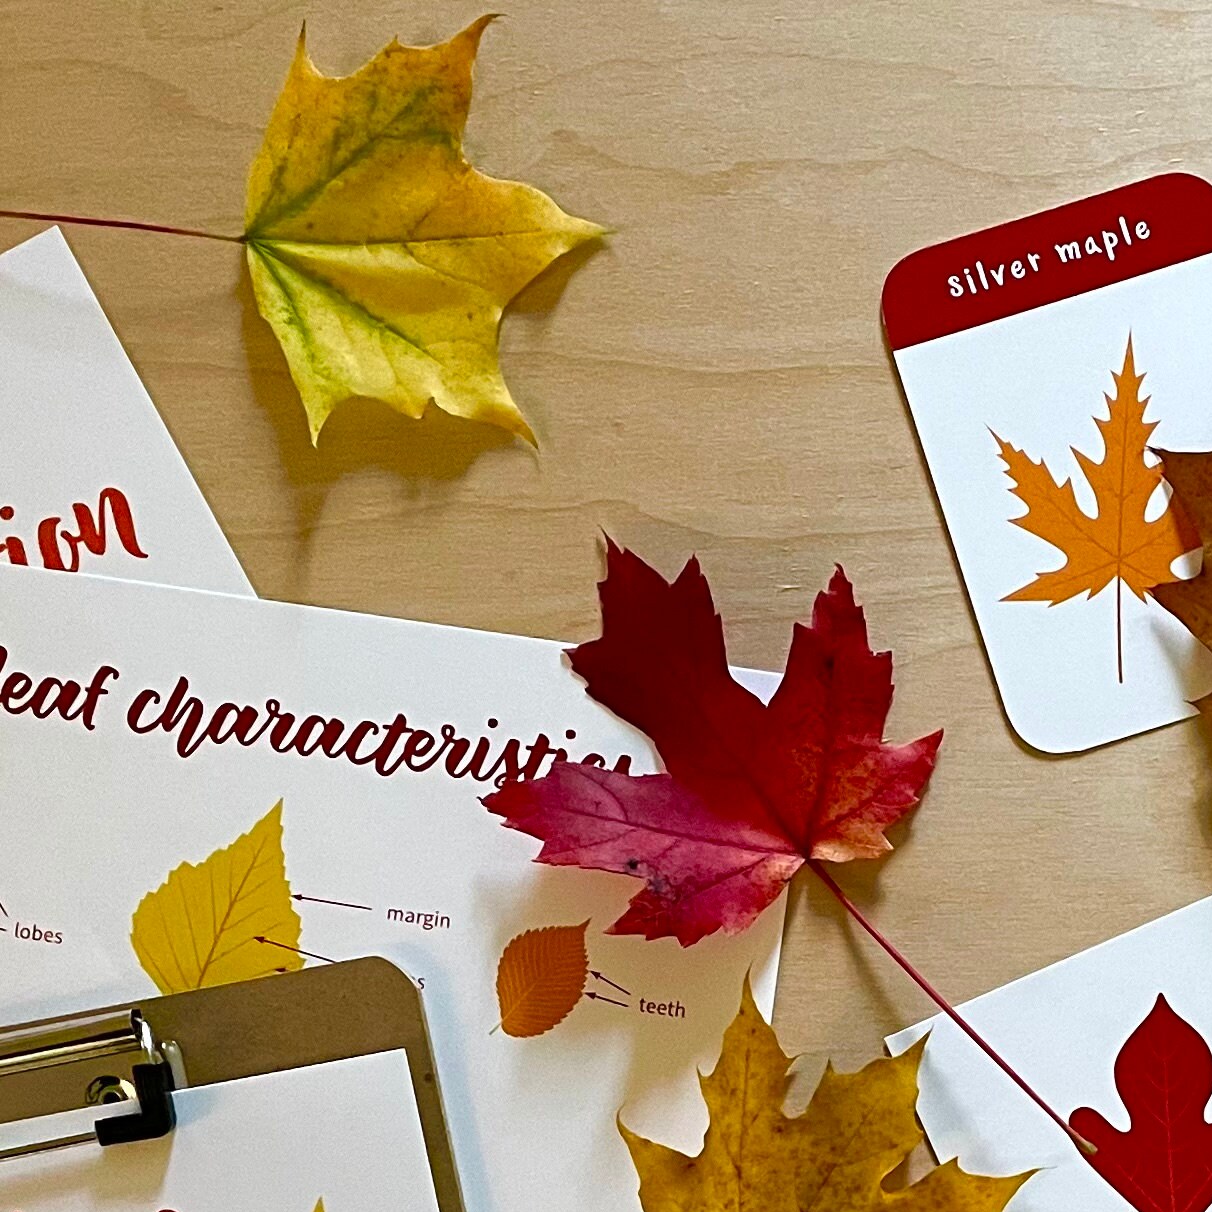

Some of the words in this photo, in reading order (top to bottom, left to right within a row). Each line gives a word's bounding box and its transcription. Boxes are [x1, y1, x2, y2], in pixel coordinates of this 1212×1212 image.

[948, 253, 1040, 297] silver
[1055, 216, 1150, 262] maple
[387, 909, 450, 930] margin
[15, 922, 63, 944] lobes
[640, 998, 685, 1018] teeth
